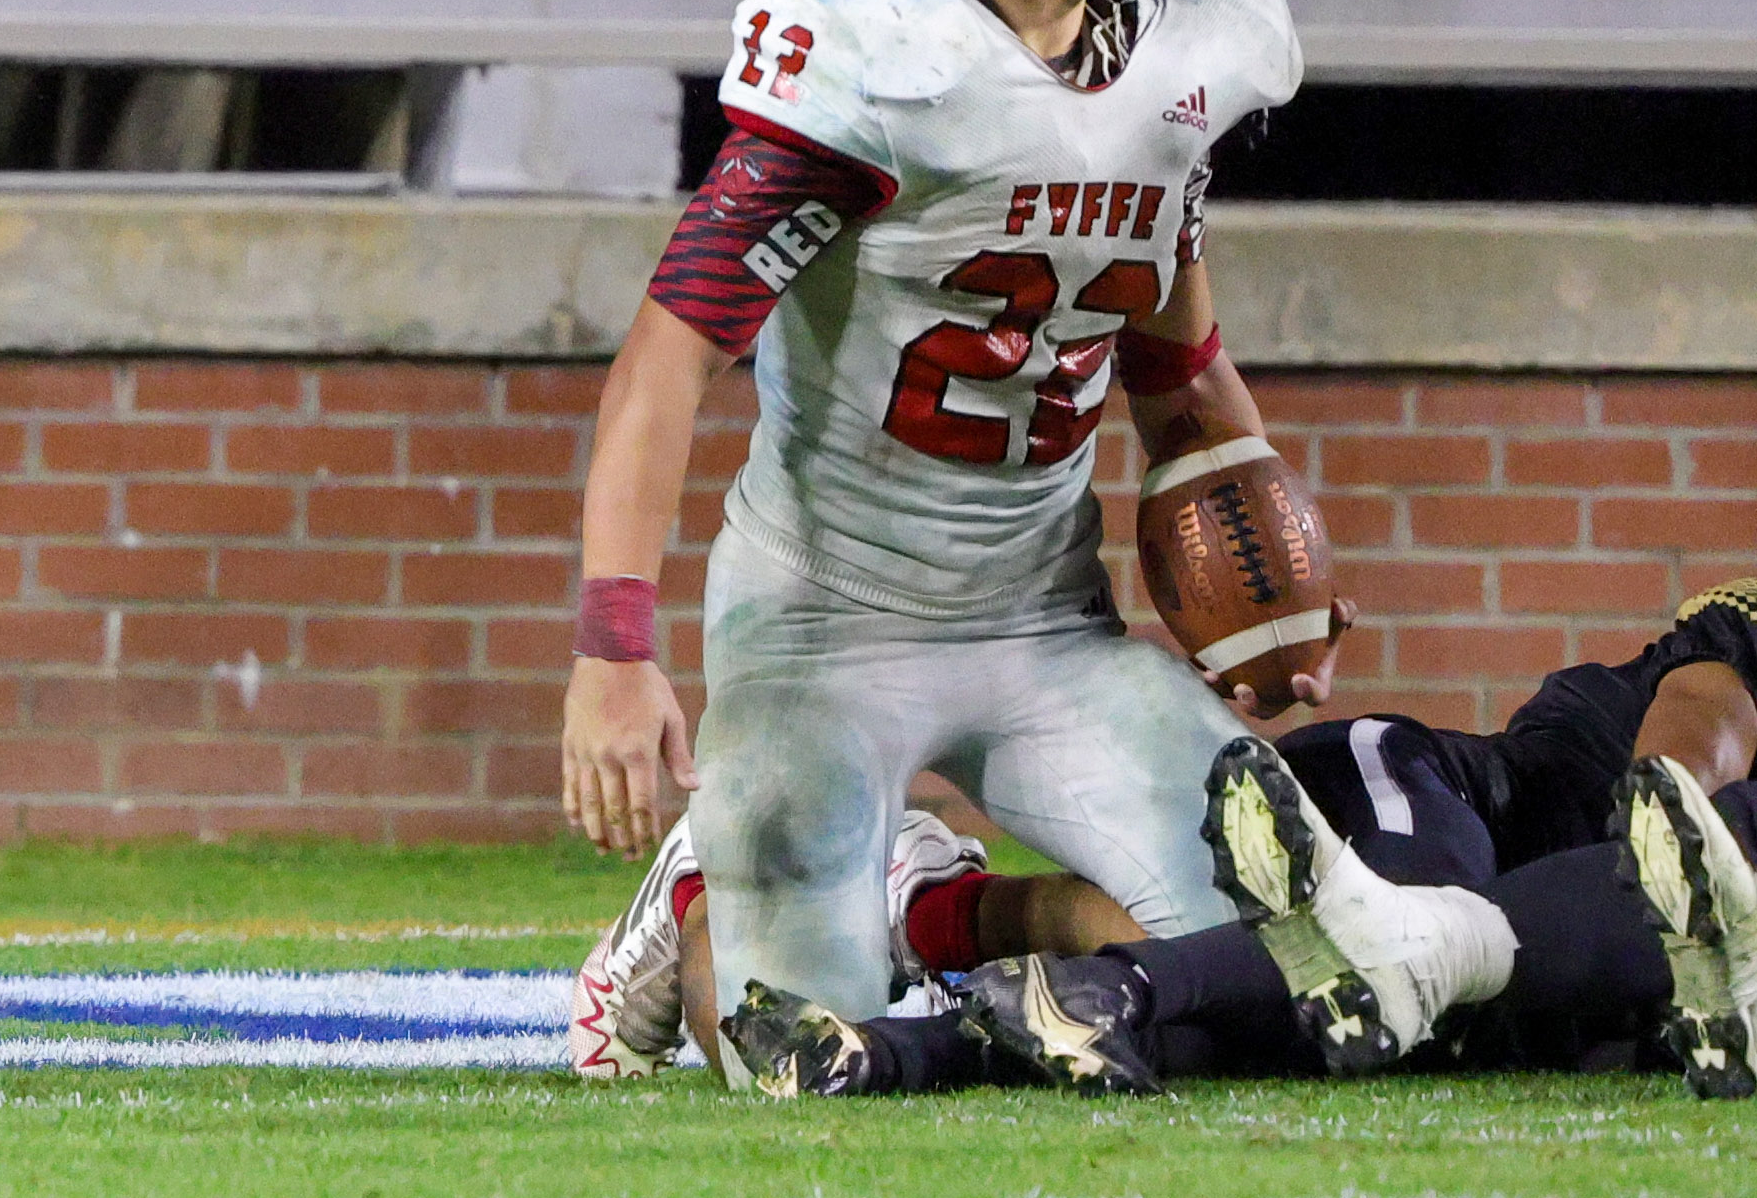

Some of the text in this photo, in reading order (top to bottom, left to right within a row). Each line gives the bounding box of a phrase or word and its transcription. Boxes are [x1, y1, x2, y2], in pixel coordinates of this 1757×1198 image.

[1162, 110, 1209, 133] adida
[741, 200, 843, 295] RED
[1005, 181, 1166, 240] FYFFE
[881, 249, 1163, 466] 22
[1268, 481, 1312, 581] Wilson
